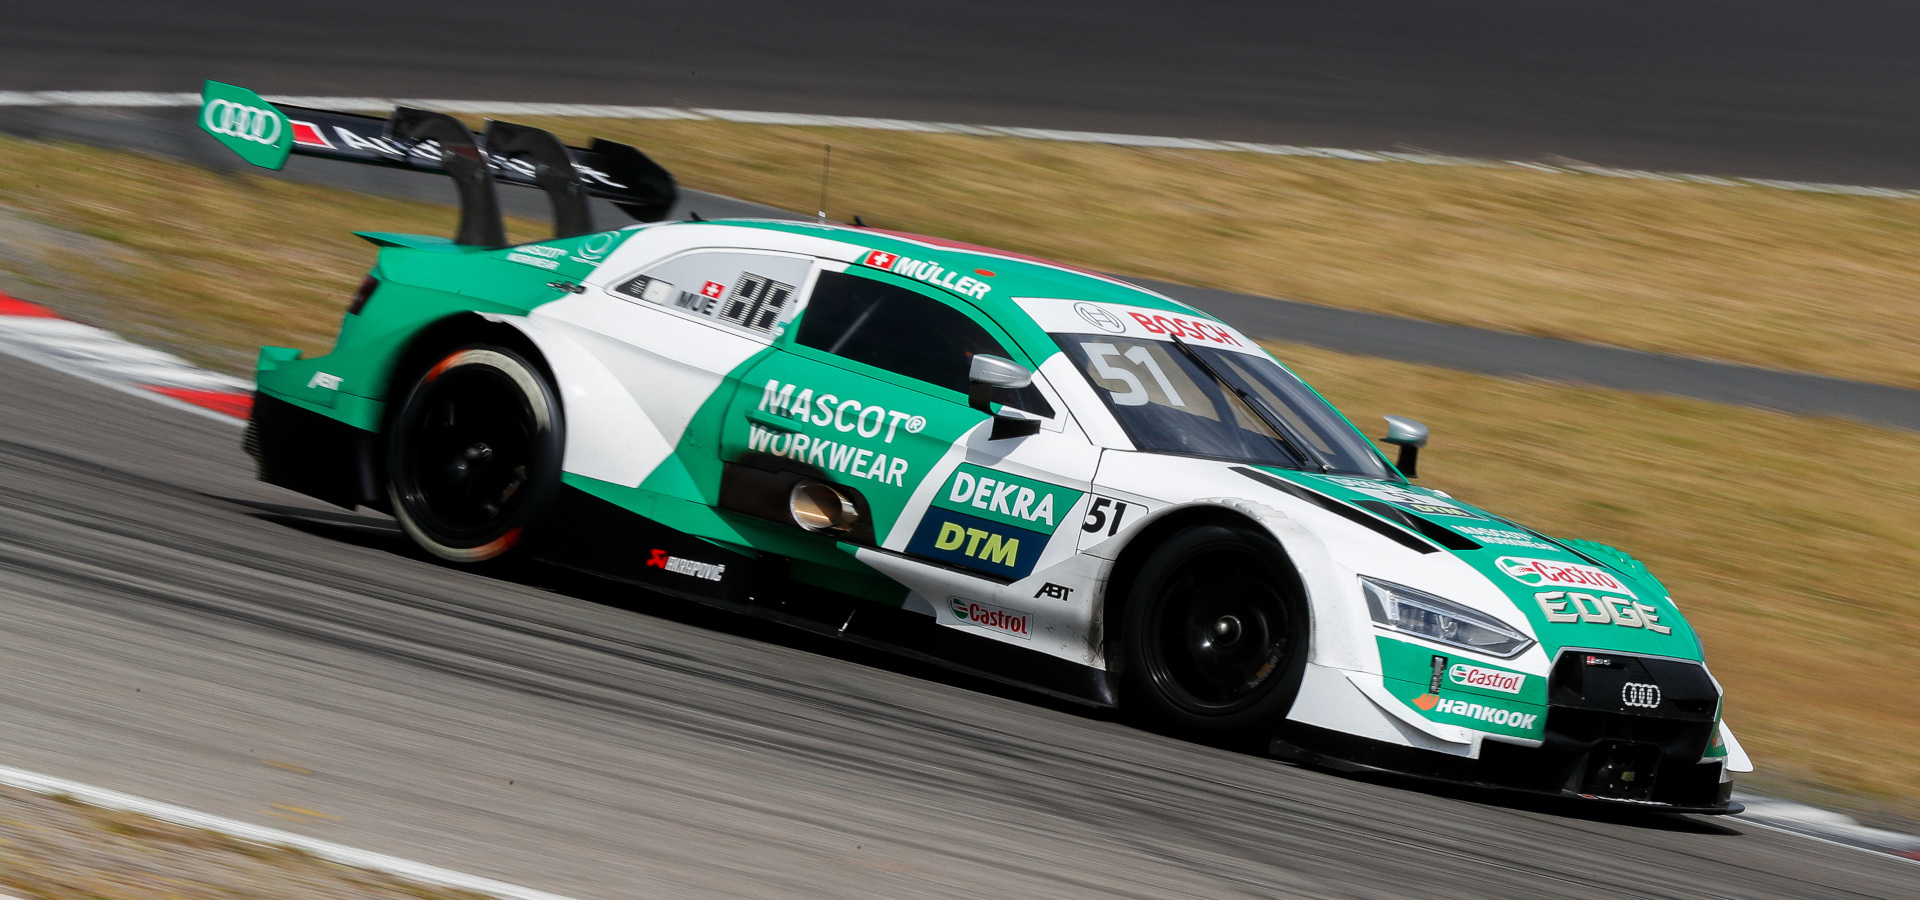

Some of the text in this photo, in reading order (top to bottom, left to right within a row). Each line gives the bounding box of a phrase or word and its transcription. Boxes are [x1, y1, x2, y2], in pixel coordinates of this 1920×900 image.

[893, 256, 992, 300] MÜLLER
[674, 290, 718, 316] MUE
[1126, 311, 1244, 348] BOSCH
[1080, 342, 1186, 407] 51
[748, 423, 909, 488] WORKWEAR
[949, 471, 1055, 527] DEKRA
[1082, 496, 1128, 538] 51
[934, 521, 1020, 568] DTM
[1033, 581, 1075, 602] ABT
[1531, 561, 1619, 590] Castro
[969, 603, 1028, 635] Castrol
[1533, 591, 1672, 636] EDGE
[1466, 668, 1520, 691] Castrol
